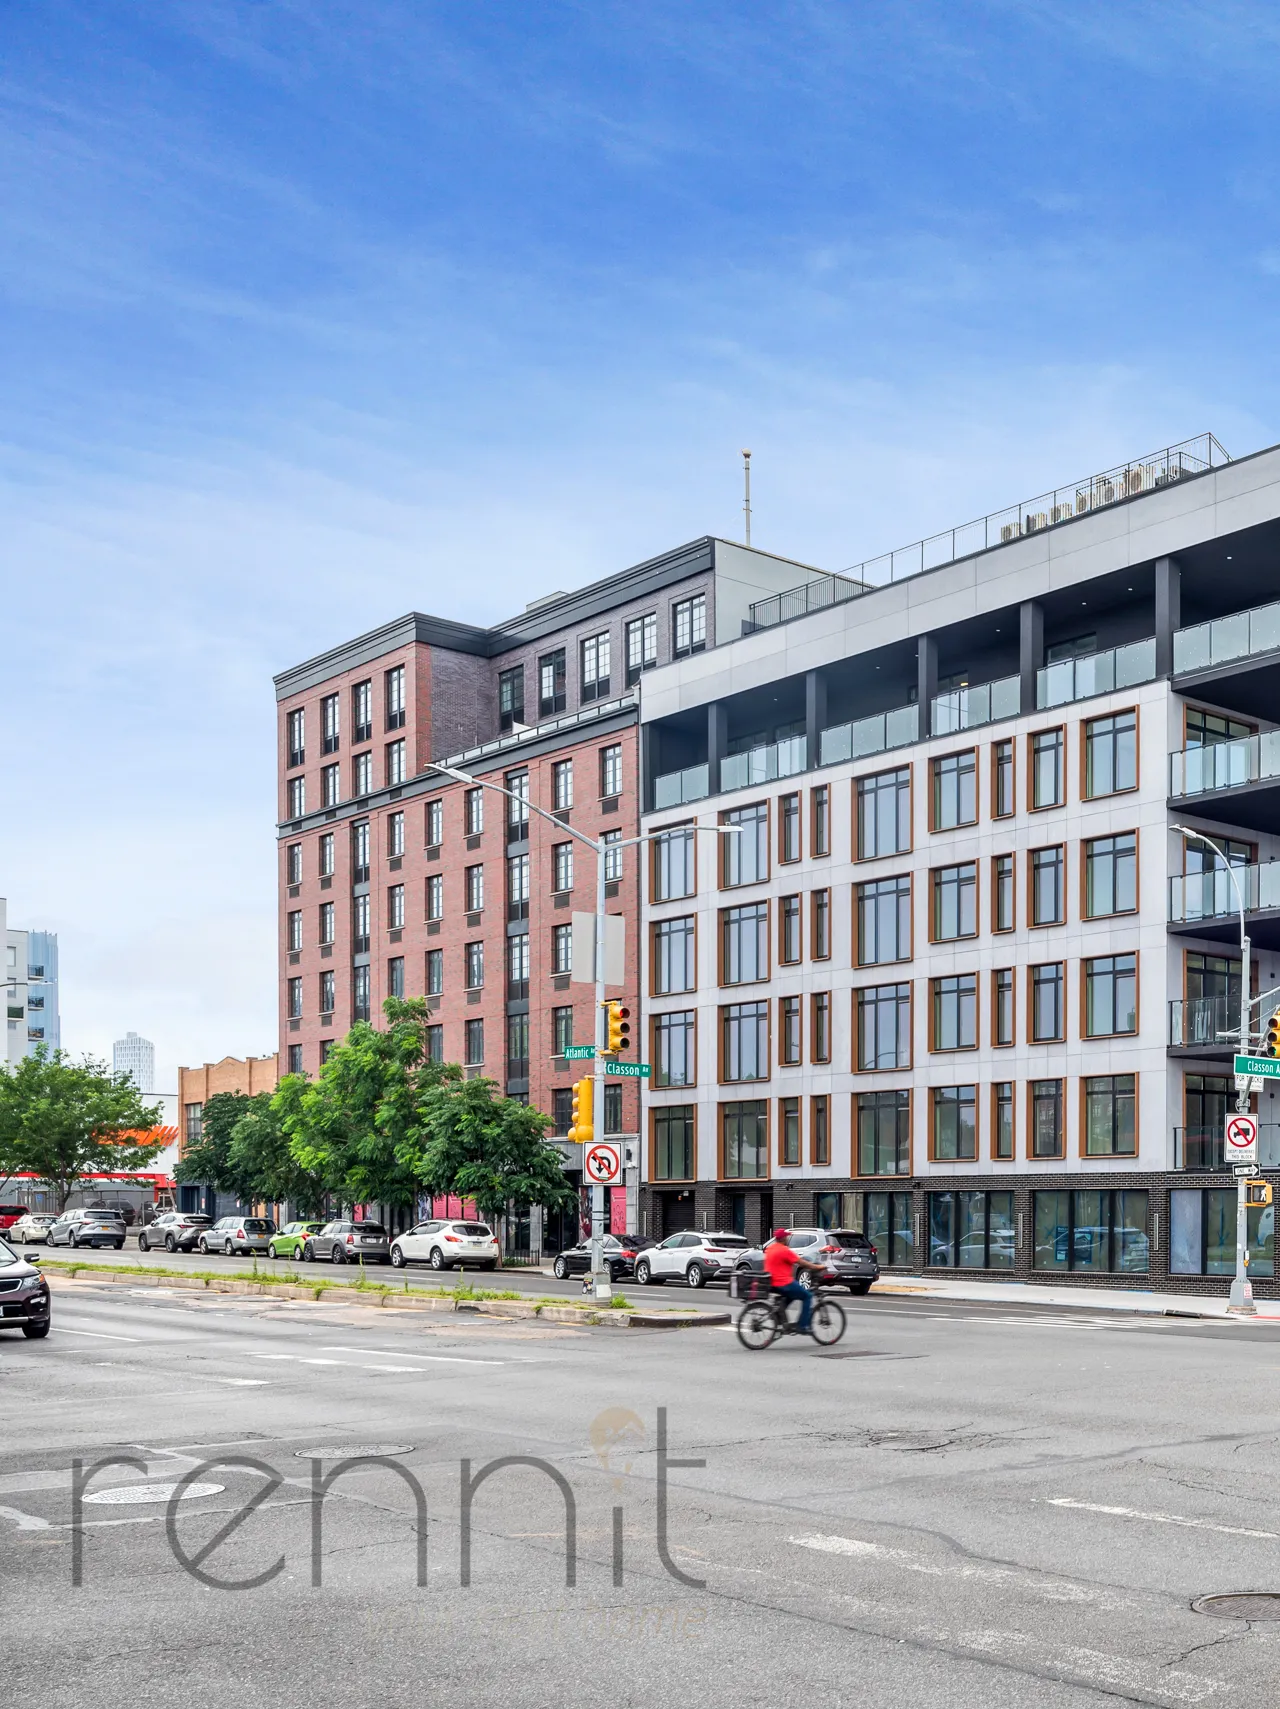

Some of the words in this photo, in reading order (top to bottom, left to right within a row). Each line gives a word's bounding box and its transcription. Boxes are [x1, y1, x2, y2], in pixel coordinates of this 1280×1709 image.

[565, 1047, 589, 1059] Atlantic
[607, 1063, 640, 1076] Classon
[1247, 1060, 1274, 1074] Classon
